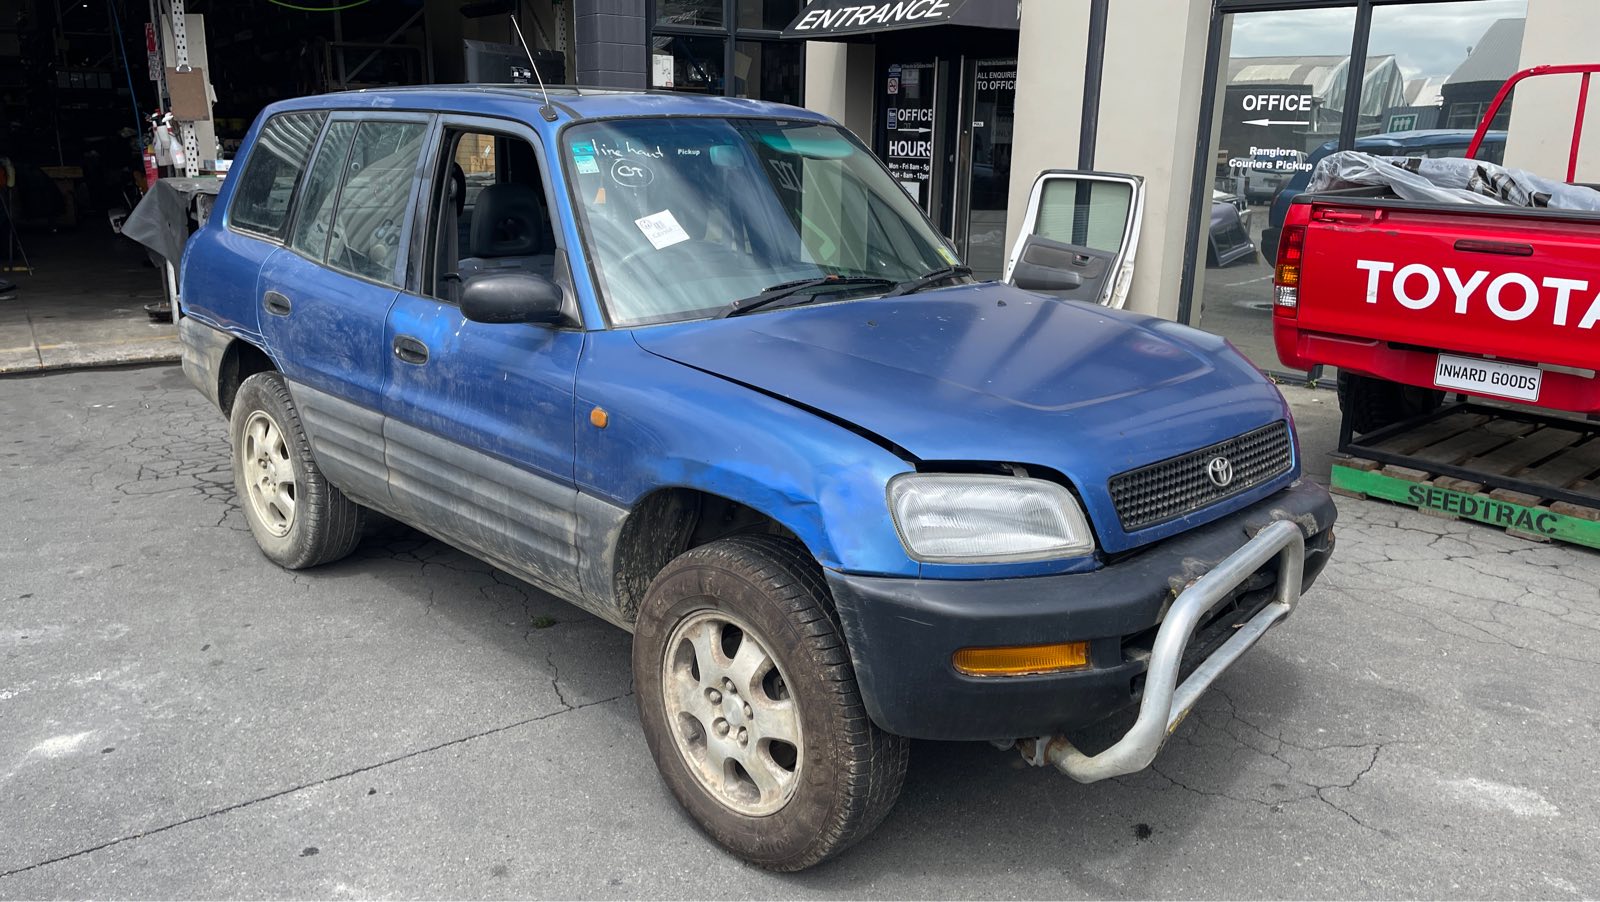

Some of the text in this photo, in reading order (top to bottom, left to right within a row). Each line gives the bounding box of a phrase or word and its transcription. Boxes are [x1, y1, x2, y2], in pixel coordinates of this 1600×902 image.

[795, 0, 949, 30] ENTRANCE
[989, 71, 1017, 79] ENQUIRIE
[977, 81, 988, 90] TO
[1242, 94, 1312, 111] OFFICE
[897, 108, 933, 121] OFFICE
[677, 148, 701, 156] Pickup
[1249, 146, 1297, 158] Rangiora
[1228, 159, 1313, 172] Couriers Pickup
[1439, 363, 1537, 391] INWARD GOODS
[1407, 485, 1558, 534] SEEDTRAC
